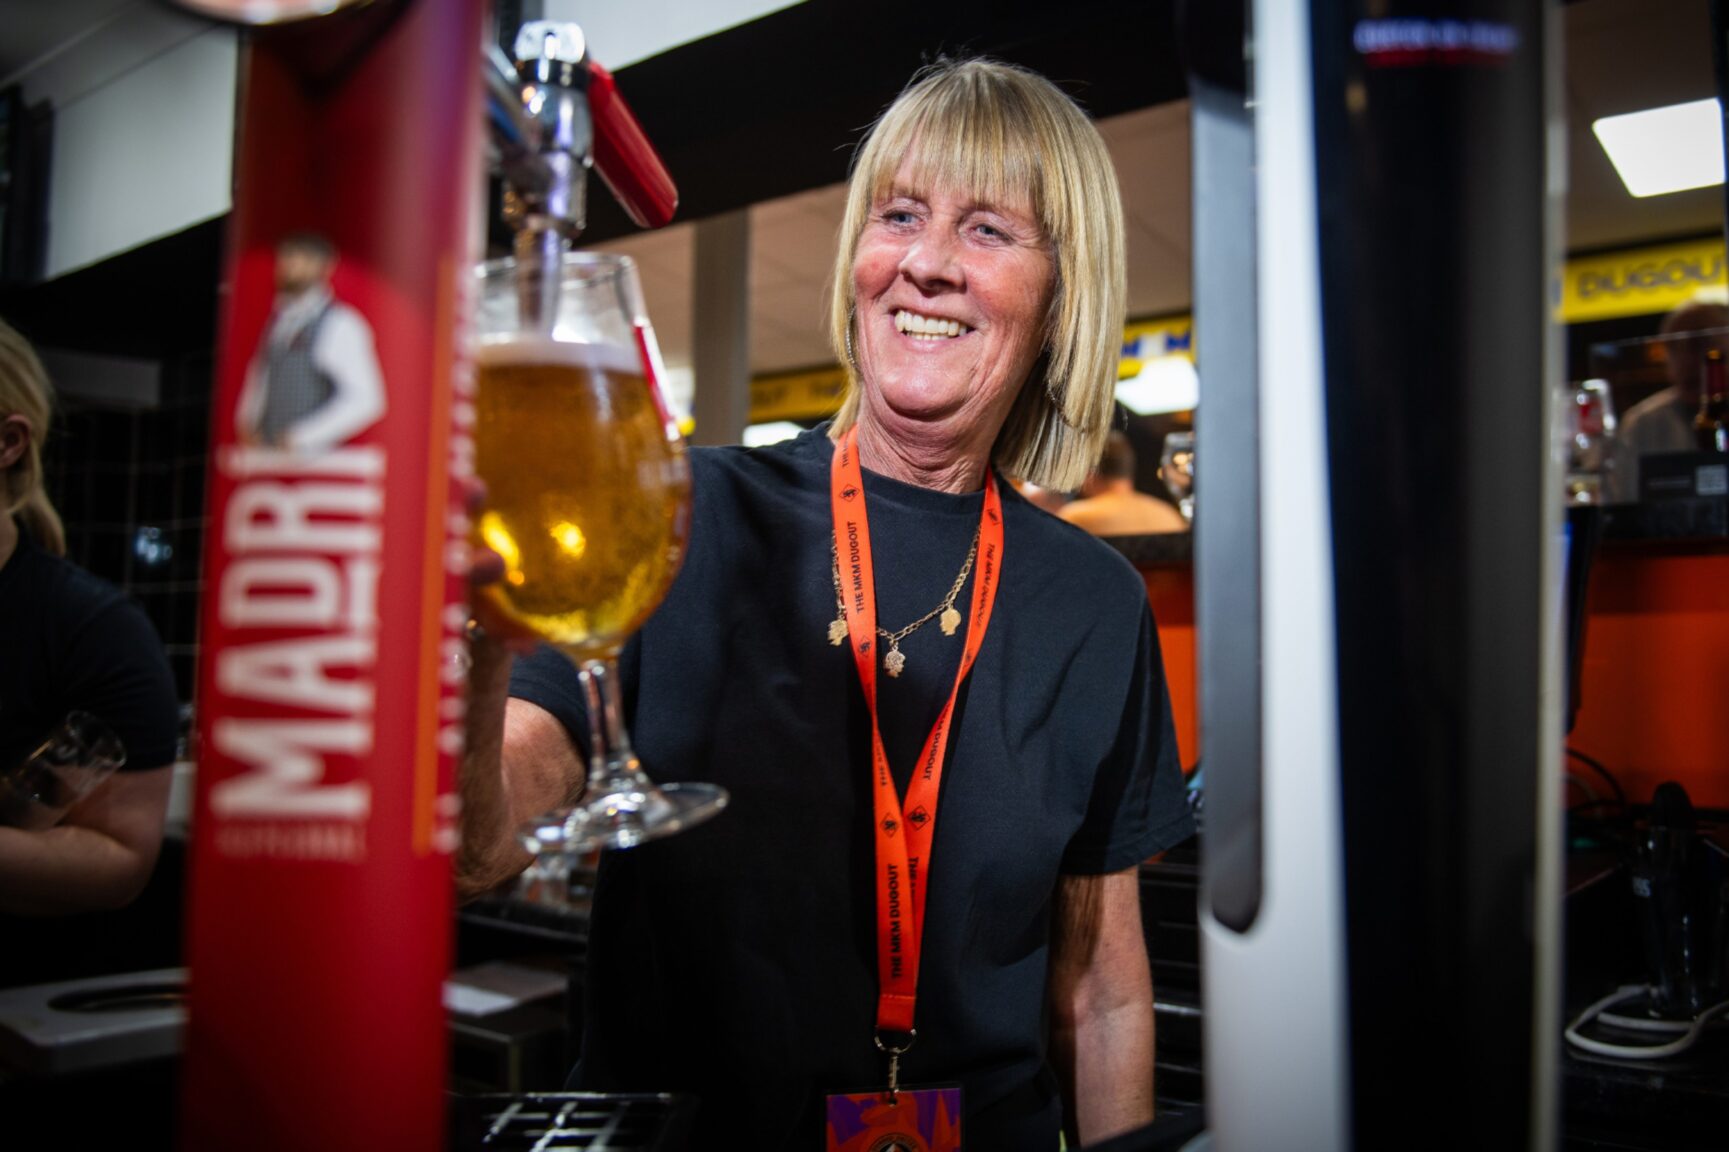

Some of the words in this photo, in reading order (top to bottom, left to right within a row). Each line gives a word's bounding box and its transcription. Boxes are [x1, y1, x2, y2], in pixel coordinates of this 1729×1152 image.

[847, 521, 860, 562] DUGOUT
[851, 564, 862, 591] MKM
[855, 592, 864, 614] THE
[923, 731, 942, 780] DUGOUT
[887, 864, 900, 917] DUGOUT
[890, 921, 902, 953] MKM
[891, 956, 902, 978] THE
